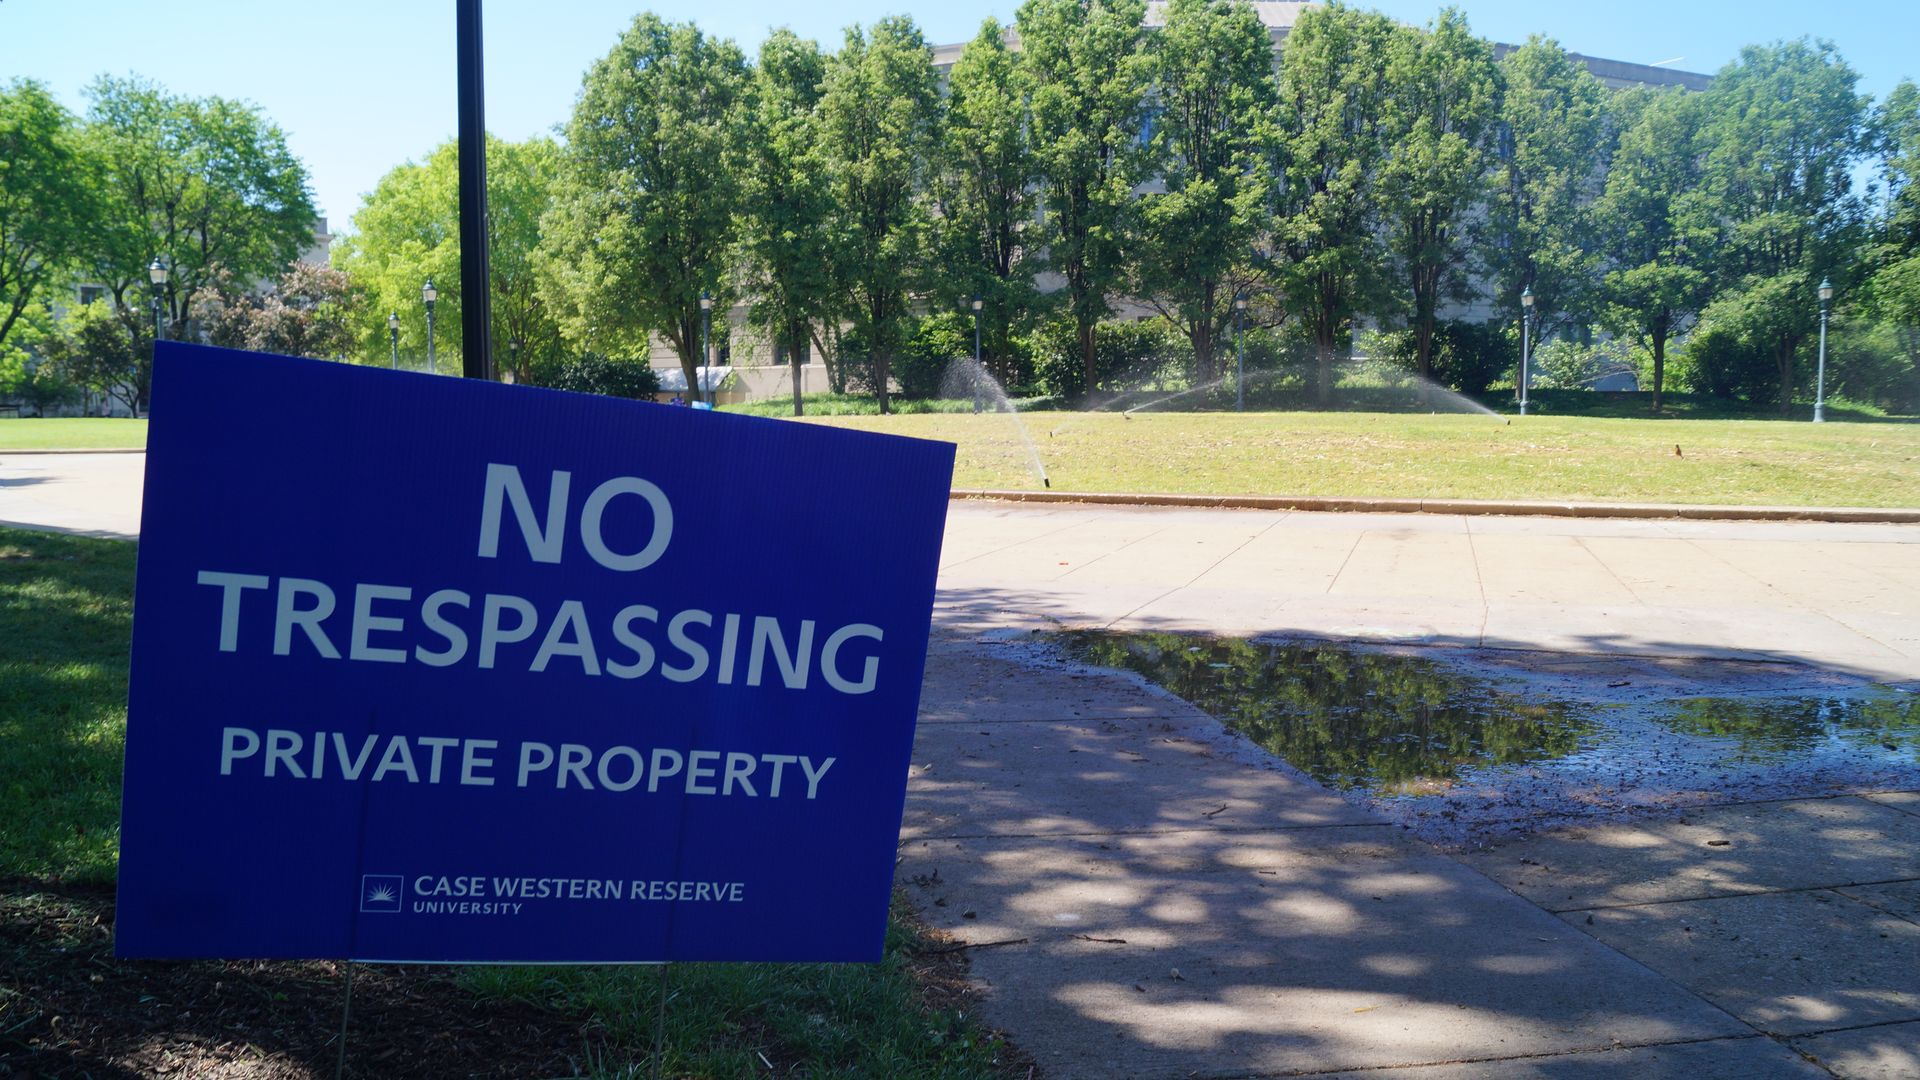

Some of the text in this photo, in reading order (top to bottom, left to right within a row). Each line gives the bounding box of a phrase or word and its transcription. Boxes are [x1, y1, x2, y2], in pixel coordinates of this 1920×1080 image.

[477, 463, 674, 572] NO
[196, 570, 884, 695] TRESPASSING
[219, 726, 836, 800] PRIVATE PROPERTY
[412, 902, 523, 914] UNIVERSITY
[413, 875, 745, 901] CASE WESTERN RESERVE
